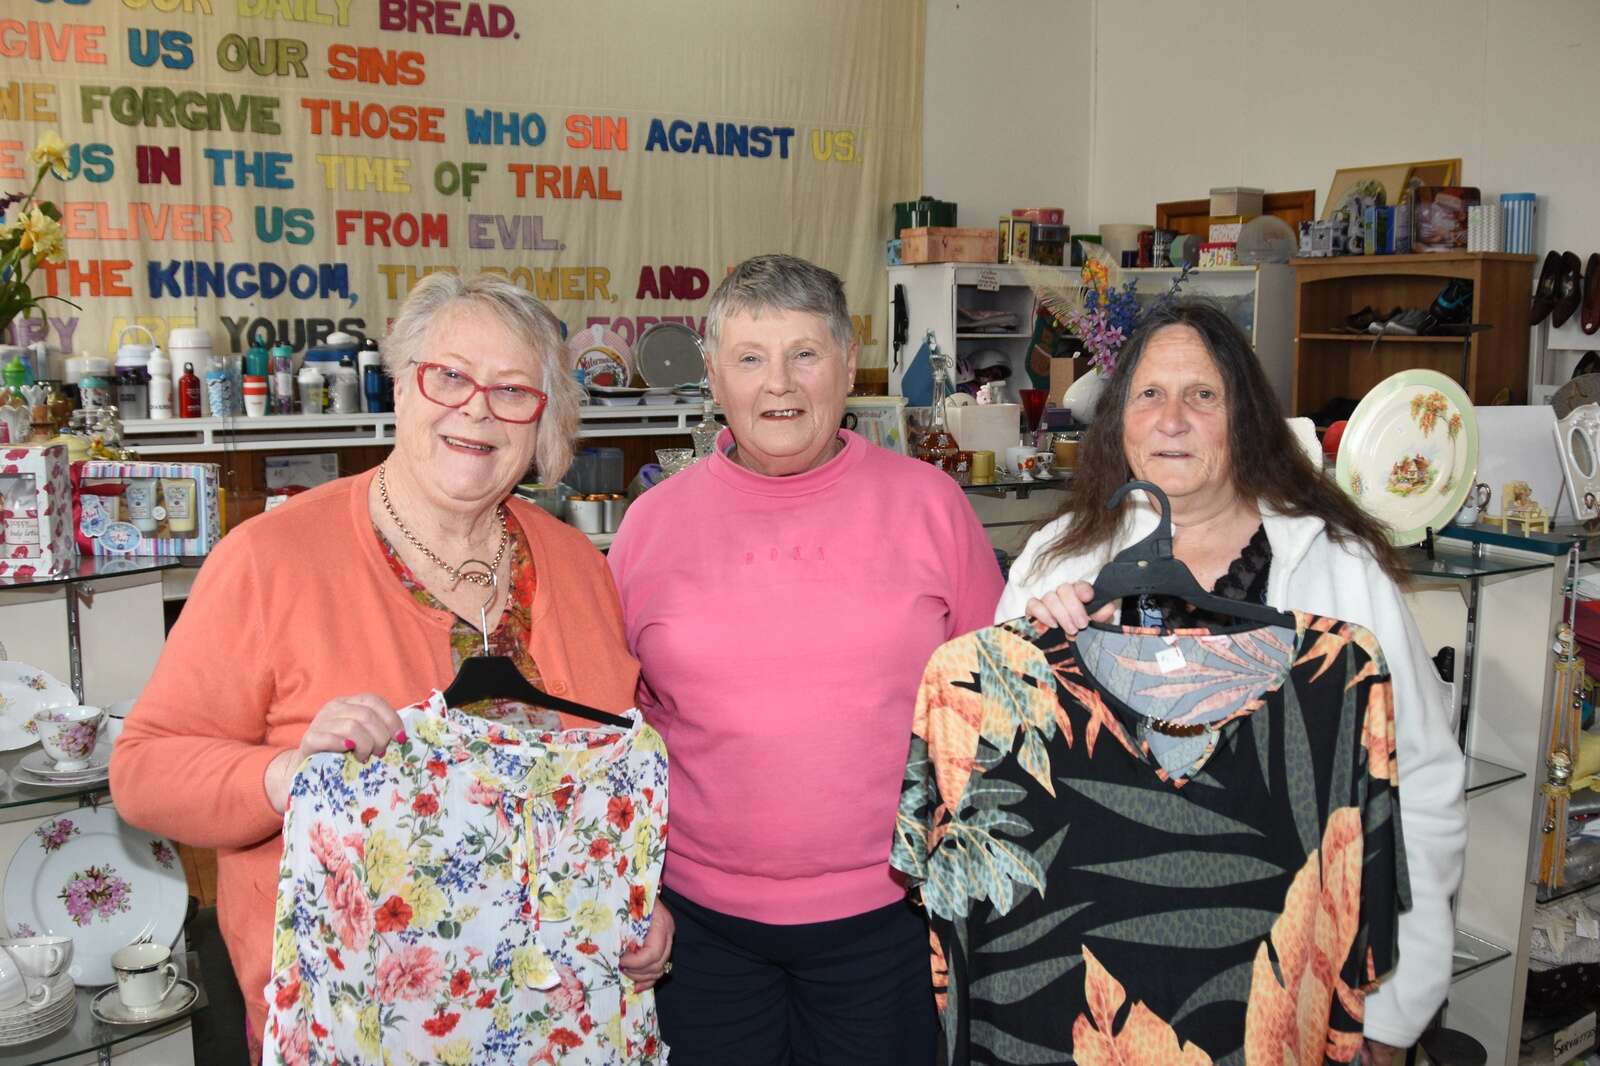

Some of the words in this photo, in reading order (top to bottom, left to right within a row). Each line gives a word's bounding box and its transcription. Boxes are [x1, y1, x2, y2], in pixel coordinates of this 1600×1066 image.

[379, 0, 520, 40] BREAD.
[0, 18, 108, 65] GIVE
[128, 28, 194, 69] US
[217, 33, 308, 78] OUR
[328, 44, 426, 86] SINS
[80, 86, 282, 135] FORGIVE
[301, 98, 446, 143] THOSE
[465, 108, 546, 147] WHO
[566, 114, 629, 152] SIN
[645, 118, 795, 159] AGAINST
[811, 129, 864, 162] US.
[136, 145, 182, 186] IN
[204, 148, 294, 190] THE
[316, 153, 412, 194] TIME
[433, 161, 487, 198] OF
[508, 163, 623, 201] TRIAL
[33, 200, 233, 242] ELIVER
[254, 205, 315, 246] US
[336, 209, 449, 249] FROM
[468, 213, 567, 251] EVIL.
[38, 259, 134, 297] THE
[147, 259, 359, 309] KINGDOM,
[378, 263, 459, 301] TH
[636, 265, 710, 301] AND
[220, 316, 368, 354] YOURS
